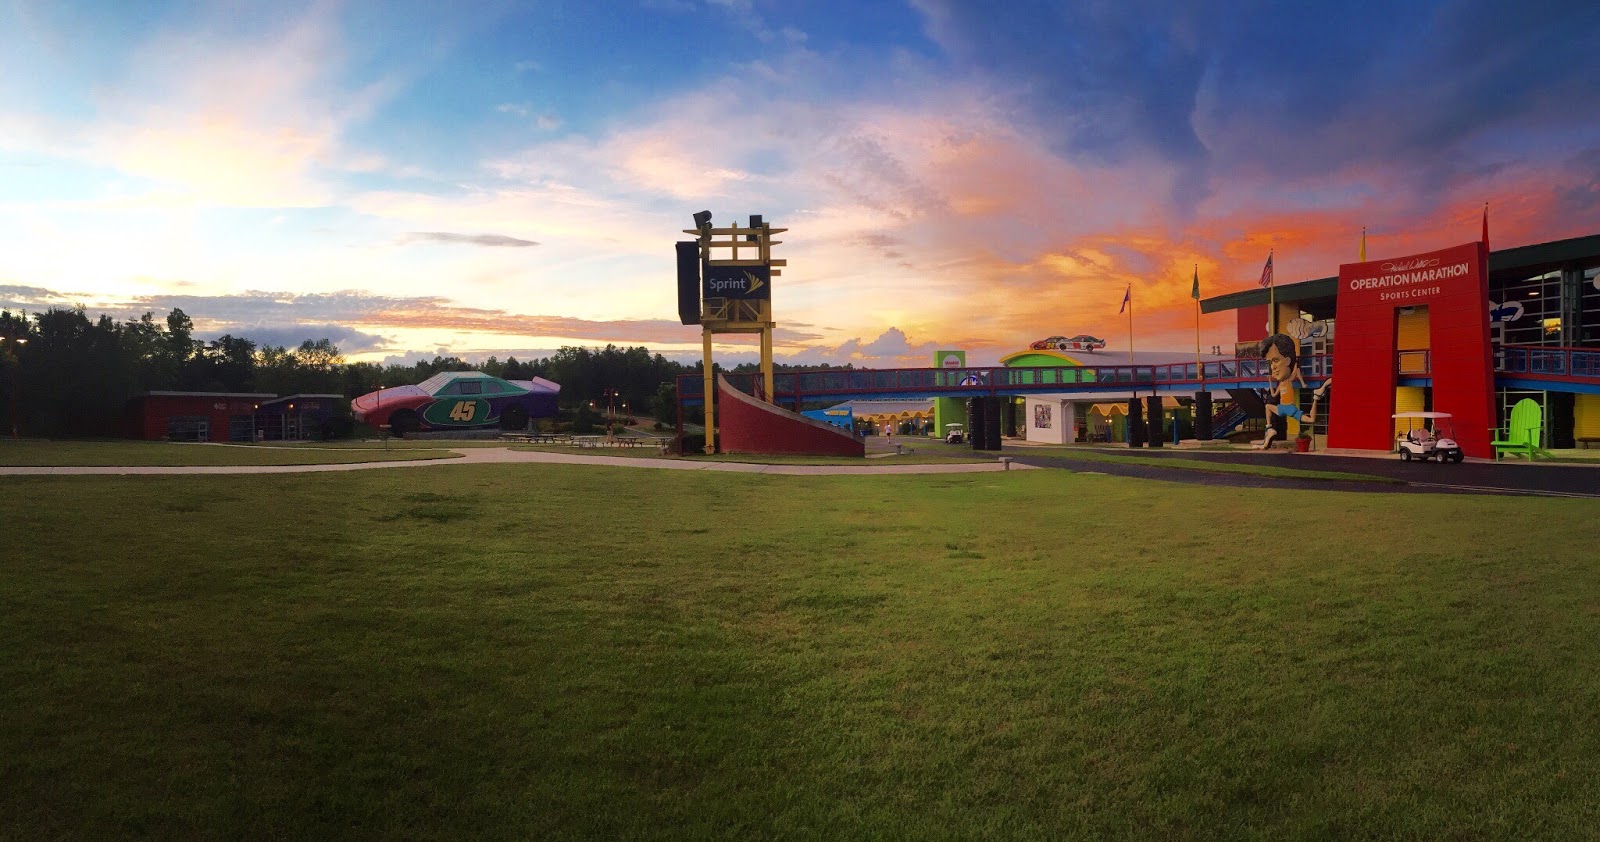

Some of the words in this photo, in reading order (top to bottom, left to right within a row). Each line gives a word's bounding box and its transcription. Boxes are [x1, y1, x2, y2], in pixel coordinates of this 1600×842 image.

[1350, 273, 1409, 290] OPERATION
[1411, 262, 1469, 283] MARATHON
[709, 278, 746, 292] Sprint
[1380, 290, 1409, 300] SPORTS
[1411, 286, 1440, 297] CENTER
[449, 401, 476, 421] 45
